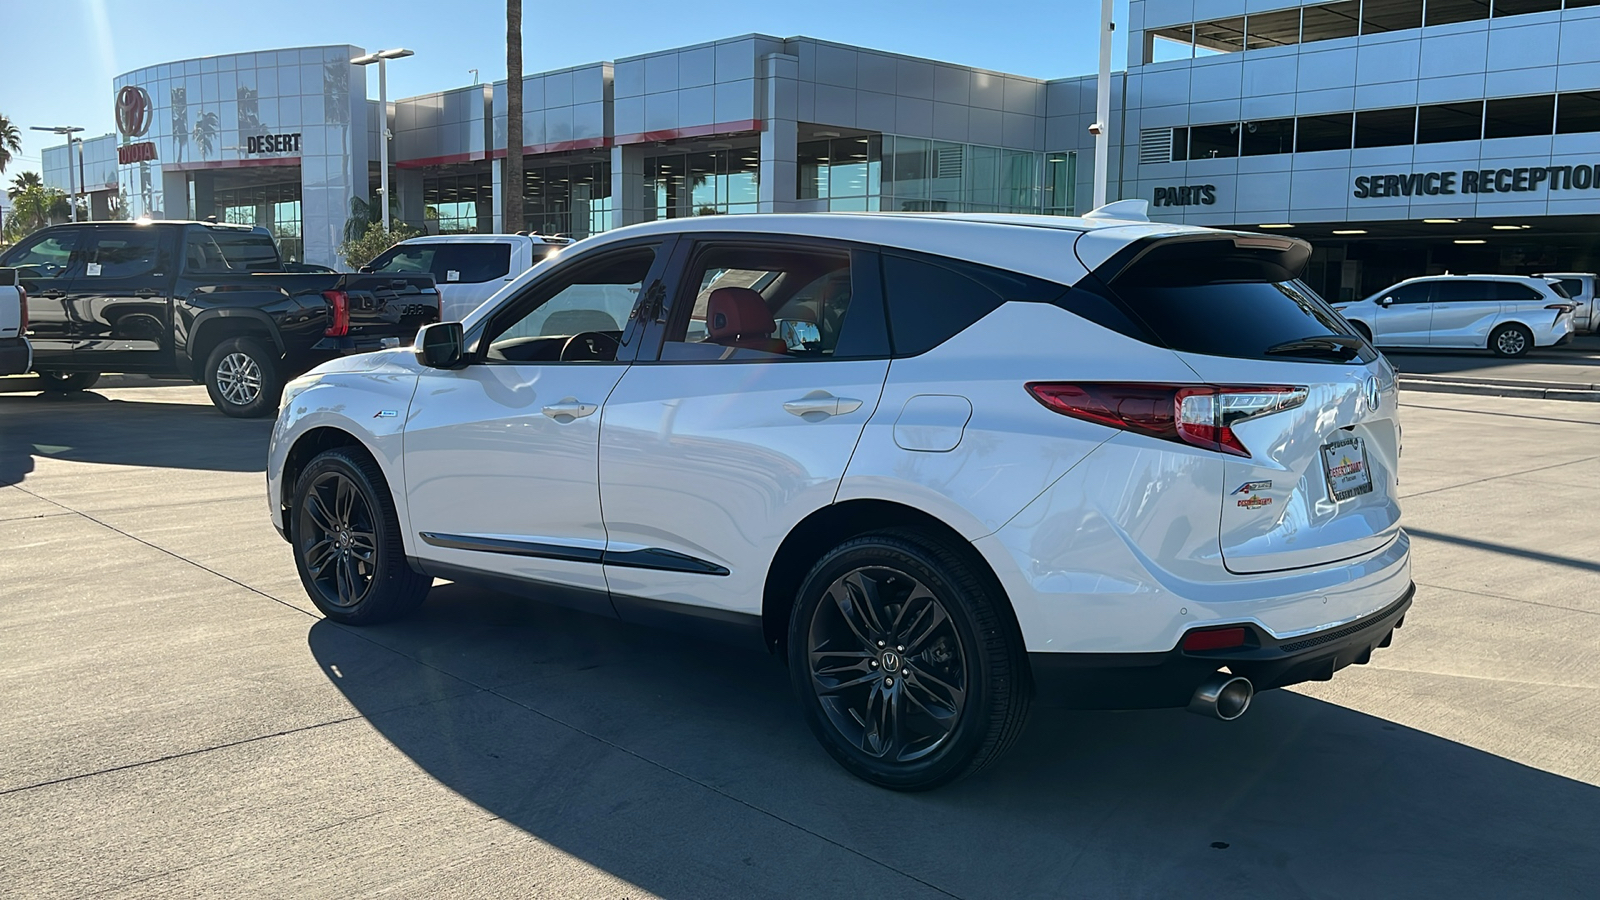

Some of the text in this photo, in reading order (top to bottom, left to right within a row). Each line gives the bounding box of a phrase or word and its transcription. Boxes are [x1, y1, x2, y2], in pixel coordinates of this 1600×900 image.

[117, 142, 154, 164] TOYOTA
[247, 133, 301, 154] DESERT
[1153, 184, 1216, 206] PARTS
[1353, 171, 1457, 199] SERVICE
